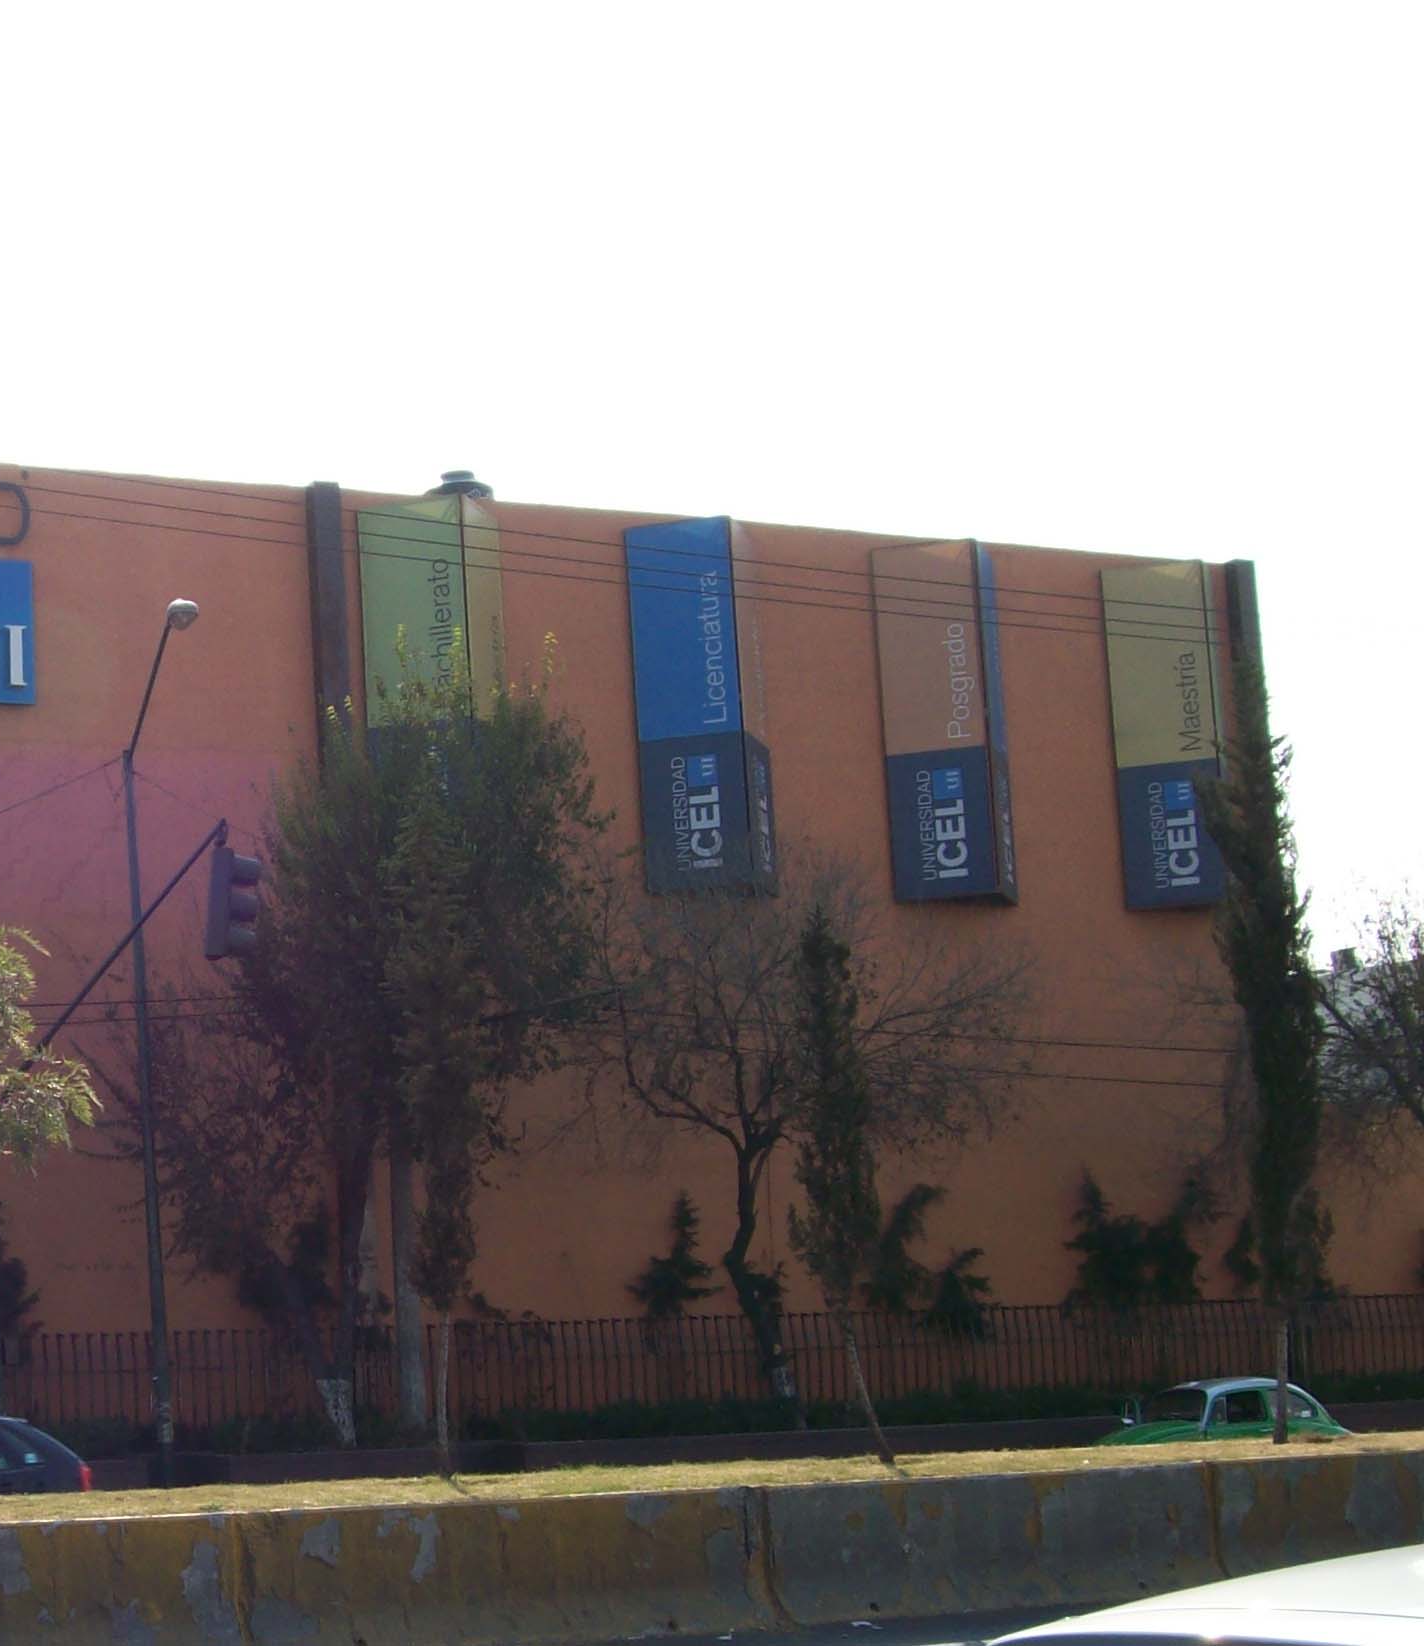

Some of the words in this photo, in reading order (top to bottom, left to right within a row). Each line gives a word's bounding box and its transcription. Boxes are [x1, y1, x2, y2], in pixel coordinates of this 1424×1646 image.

[428, 558, 456, 703] achillerato
[696, 570, 727, 724] Licenciatura
[942, 623, 975, 739] Posgrado
[670, 756, 692, 872] UNIVERSIDAD
[689, 786, 723, 869] ICEL
[916, 769, 937, 881] UNIVERSIDAD
[935, 799, 968, 879] ICEL
[1148, 781, 1169, 889] UNIVERSIDAD
[1166, 809, 1200, 887] ICEL
